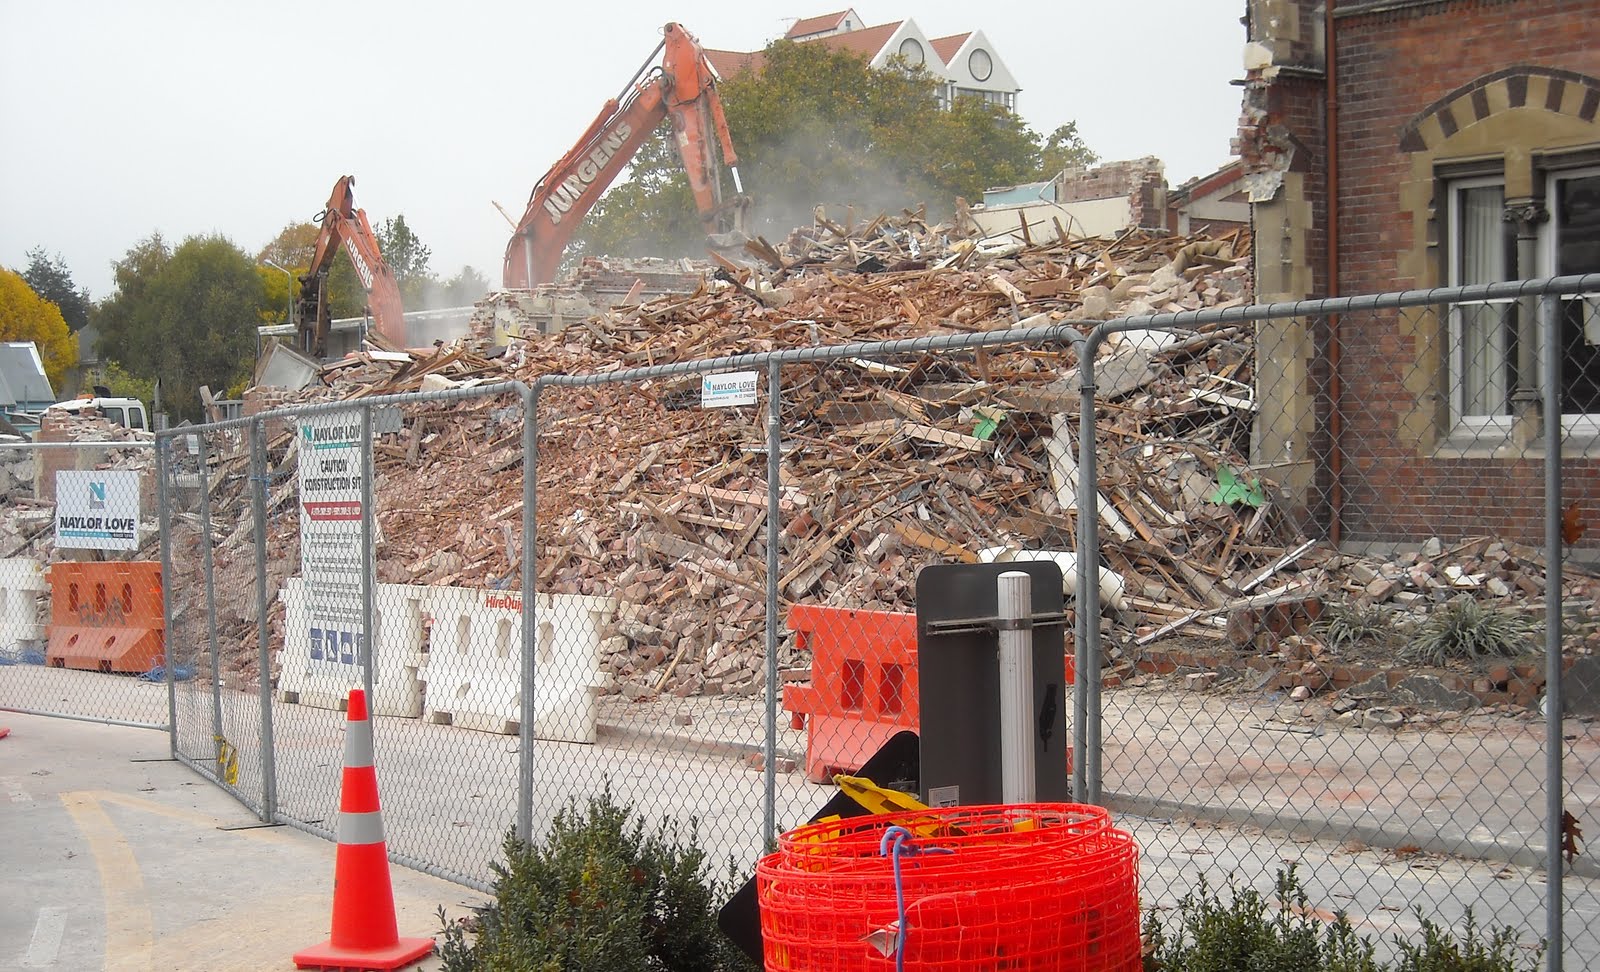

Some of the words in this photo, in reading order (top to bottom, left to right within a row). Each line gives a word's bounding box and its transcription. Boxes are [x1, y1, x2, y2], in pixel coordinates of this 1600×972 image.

[543, 120, 632, 225] JURGENS
[346, 425, 361, 440] LOV
[320, 459, 348, 473] CAUTION
[304, 477, 350, 491] CONSTRUCTION
[352, 476, 362, 490] SIT
[60, 516, 102, 529] NAYLOR
[105, 518, 135, 530] LOVE
